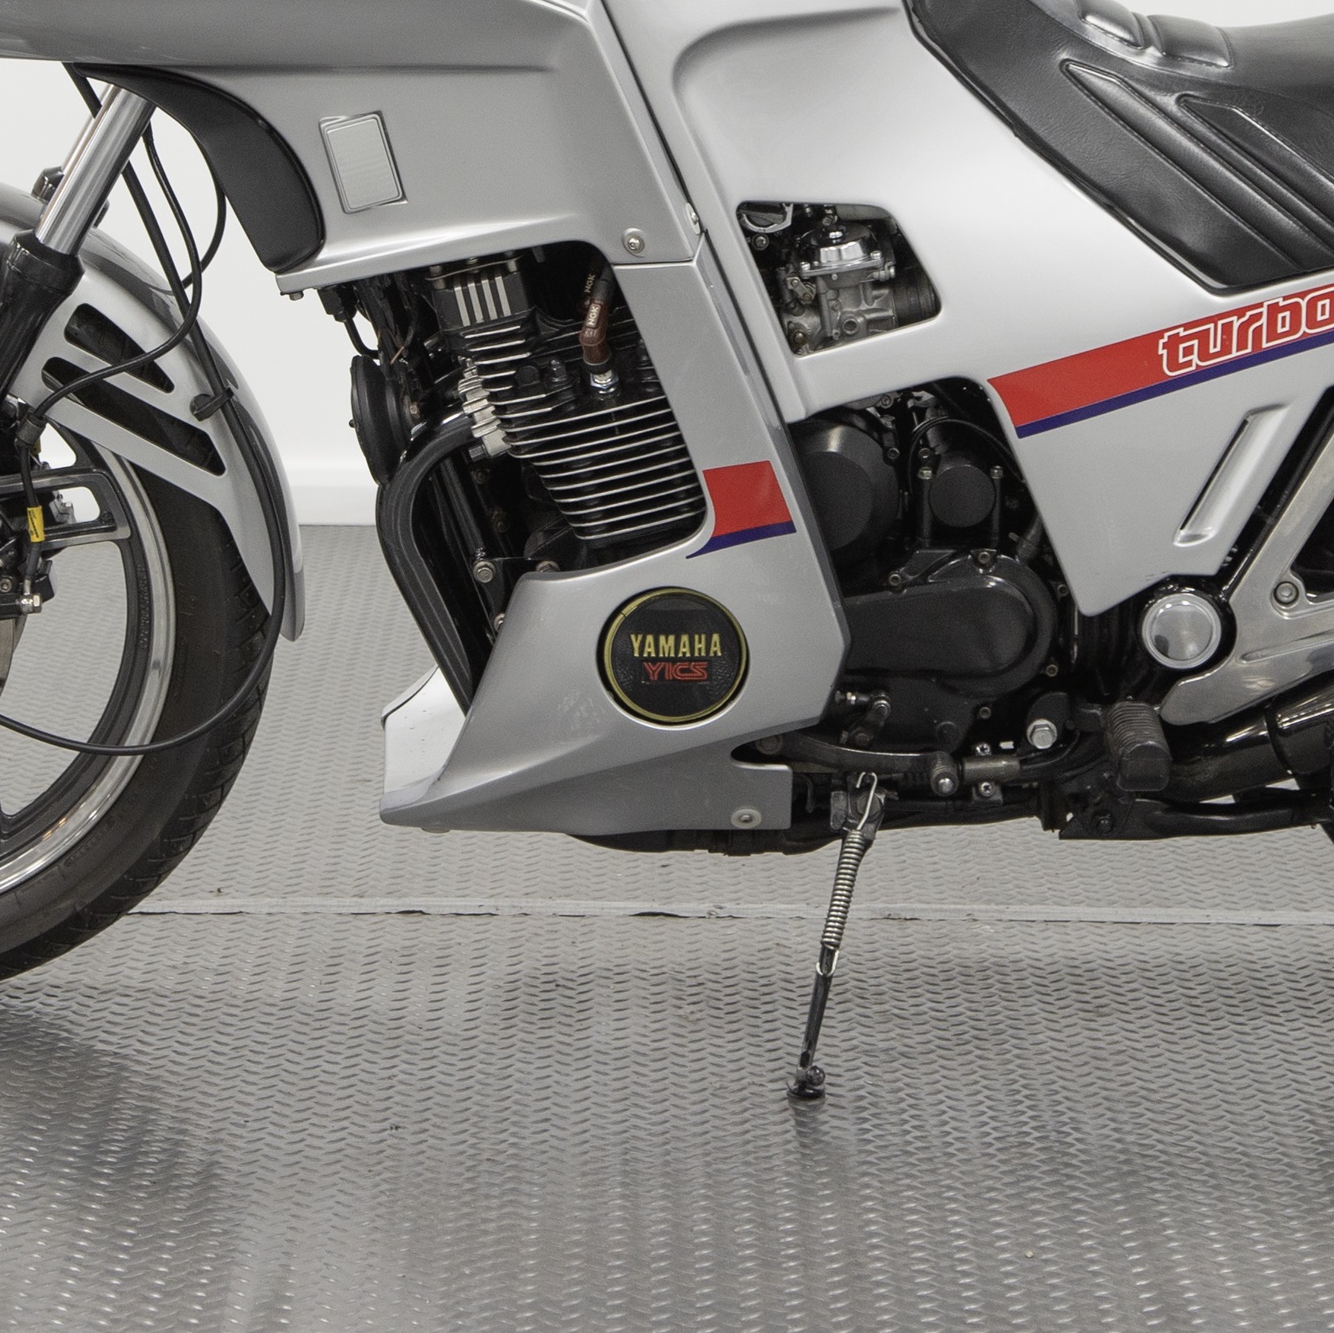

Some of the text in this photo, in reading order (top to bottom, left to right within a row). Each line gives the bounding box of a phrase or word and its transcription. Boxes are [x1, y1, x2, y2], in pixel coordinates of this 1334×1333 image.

[584, 273, 596, 293] NGK
[586, 305, 599, 327] NGK
[629, 633, 722, 657] YAMAHA
[642, 661, 709, 681] YICS
